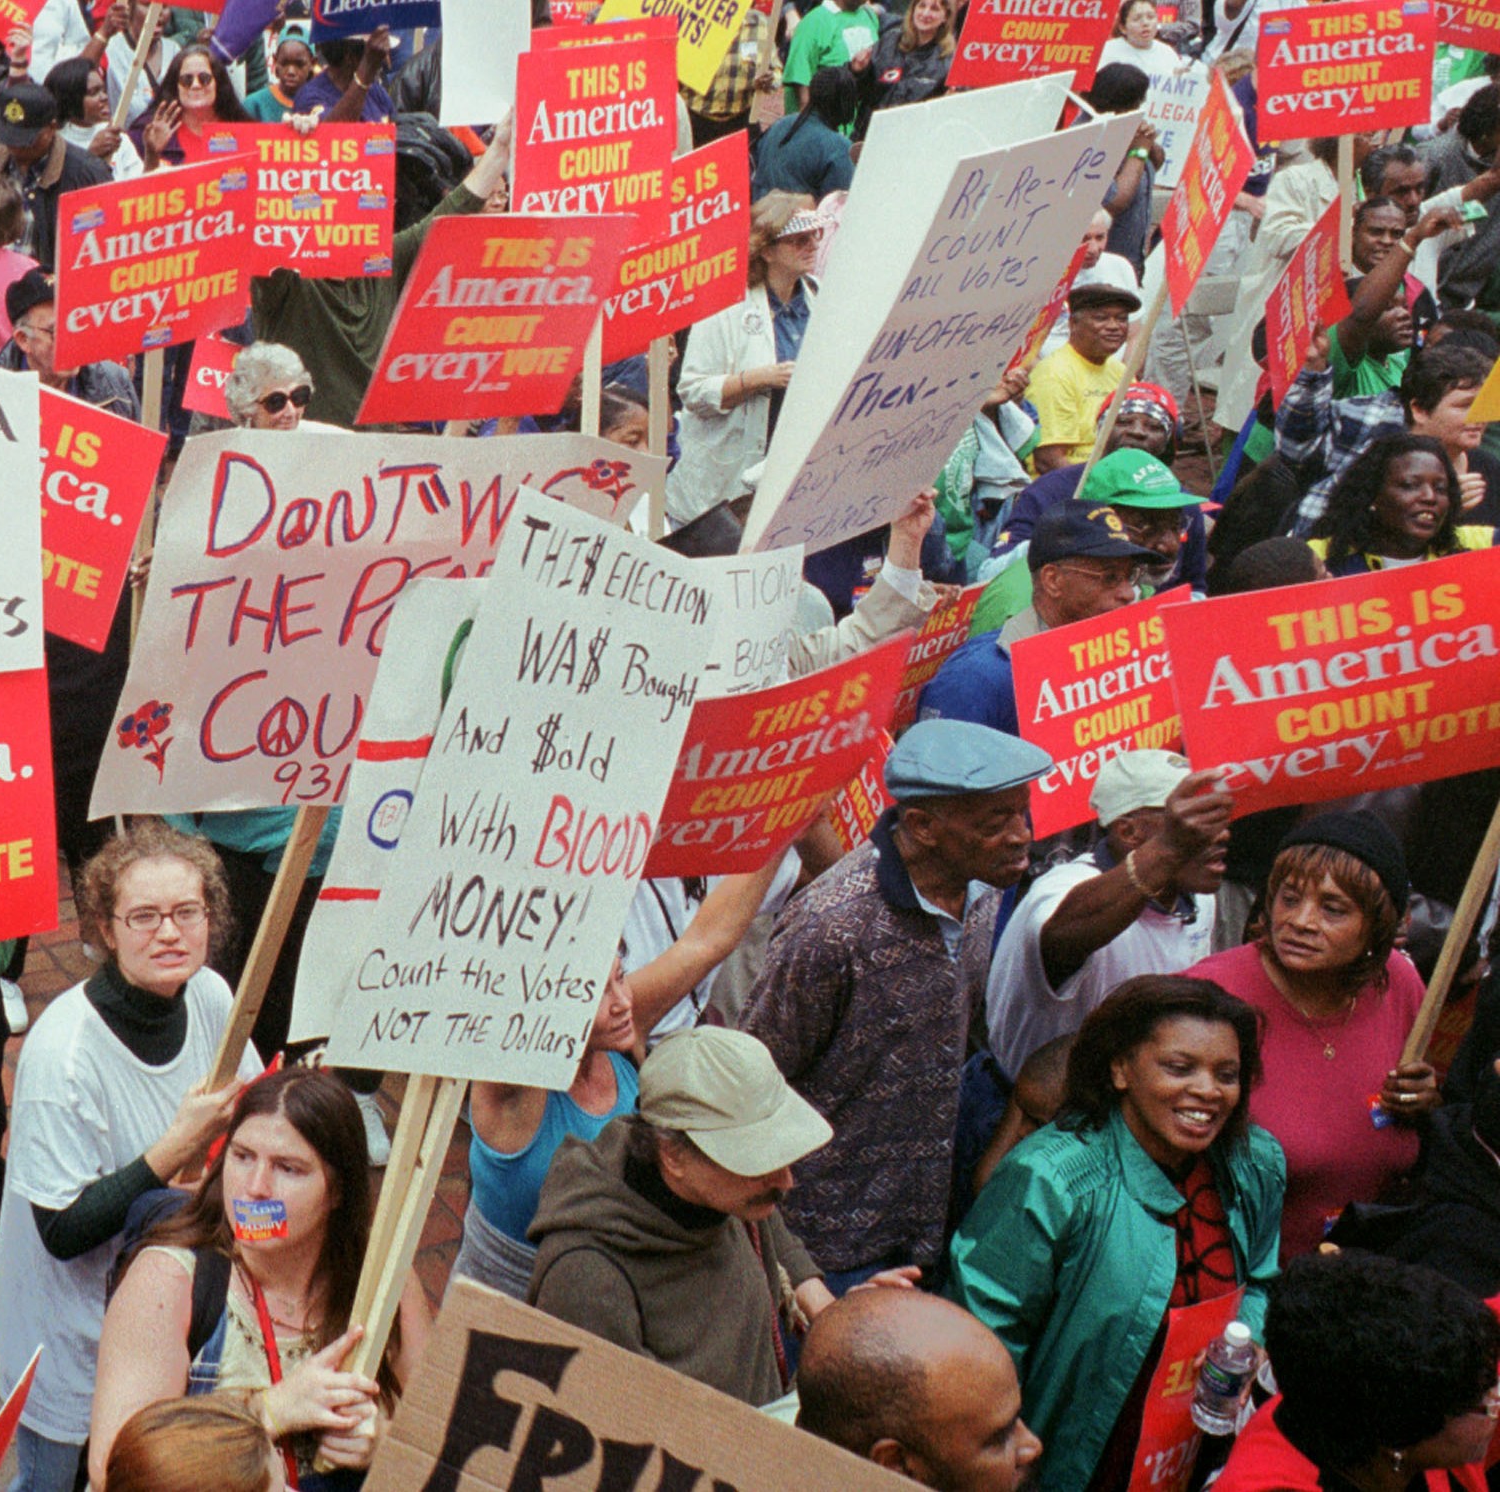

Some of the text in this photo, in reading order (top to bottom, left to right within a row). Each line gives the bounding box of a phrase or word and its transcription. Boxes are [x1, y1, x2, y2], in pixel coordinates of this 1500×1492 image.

[688, 0, 739, 29] OTER
[978, 0, 1108, 19] America.
[1001, 20, 1069, 41] COUNT
[1308, 9, 1403, 38] THIS IS
[1465, 8, 1500, 29] VOT
[962, 41, 1094, 71] every VOTE
[1268, 29, 1426, 67] America.
[566, 60, 647, 99] THIS IS
[1302, 61, 1383, 88] COUNT
[526, 90, 664, 145] America.
[1148, 102, 1197, 124] LEGA
[1265, 79, 1422, 117] every VOTE
[256, 139, 359, 163] THIS IS
[559, 140, 632, 181] COUNT
[520, 170, 664, 215] every VOTE
[695, 162, 719, 194] IS
[118, 180, 223, 226] THIS IS
[256, 197, 338, 221] COUNT
[669, 190, 741, 238] rica.
[71, 209, 246, 270] America.
[253, 224, 380, 258] ery VOTE
[481, 237, 595, 268] THIS IS
[927, 203, 1050, 264] COUNT
[109, 250, 200, 293] COUNT
[620, 234, 701, 287] COUNT
[66, 269, 239, 333] every VOTE
[414, 264, 597, 308] America.
[603, 247, 737, 321] very VOTE
[900, 273, 944, 303] ALL
[443, 315, 544, 345] COUNT
[385, 346, 574, 393] every VOTE
[54, 424, 102, 468] IS
[41, 549, 102, 600] OTE
[171, 572, 326, 655] THE
[1267, 583, 1466, 652] THIS IS
[1069, 616, 1165, 672] THIS IS
[516, 617, 698, 724] WA$ Bought
[199, 670, 363, 764] COU
[748, 672, 872, 739] THIS IS
[1073, 694, 1152, 747] COUNT
[1276, 681, 1435, 744] COUNT
[533, 713, 617, 782] $old
[675, 711, 876, 782] America.
[1213, 730, 1392, 793] every
[690, 766, 815, 814] COUNT
[439, 793, 518, 860] With
[652, 811, 765, 854] very
[764, 787, 843, 833] VOT
[409, 874, 593, 952] MONEY!
[357, 949, 599, 1003] Count the Votes
[360, 1010, 432, 1052] NOT
[445, 1011, 490, 1046] THE
